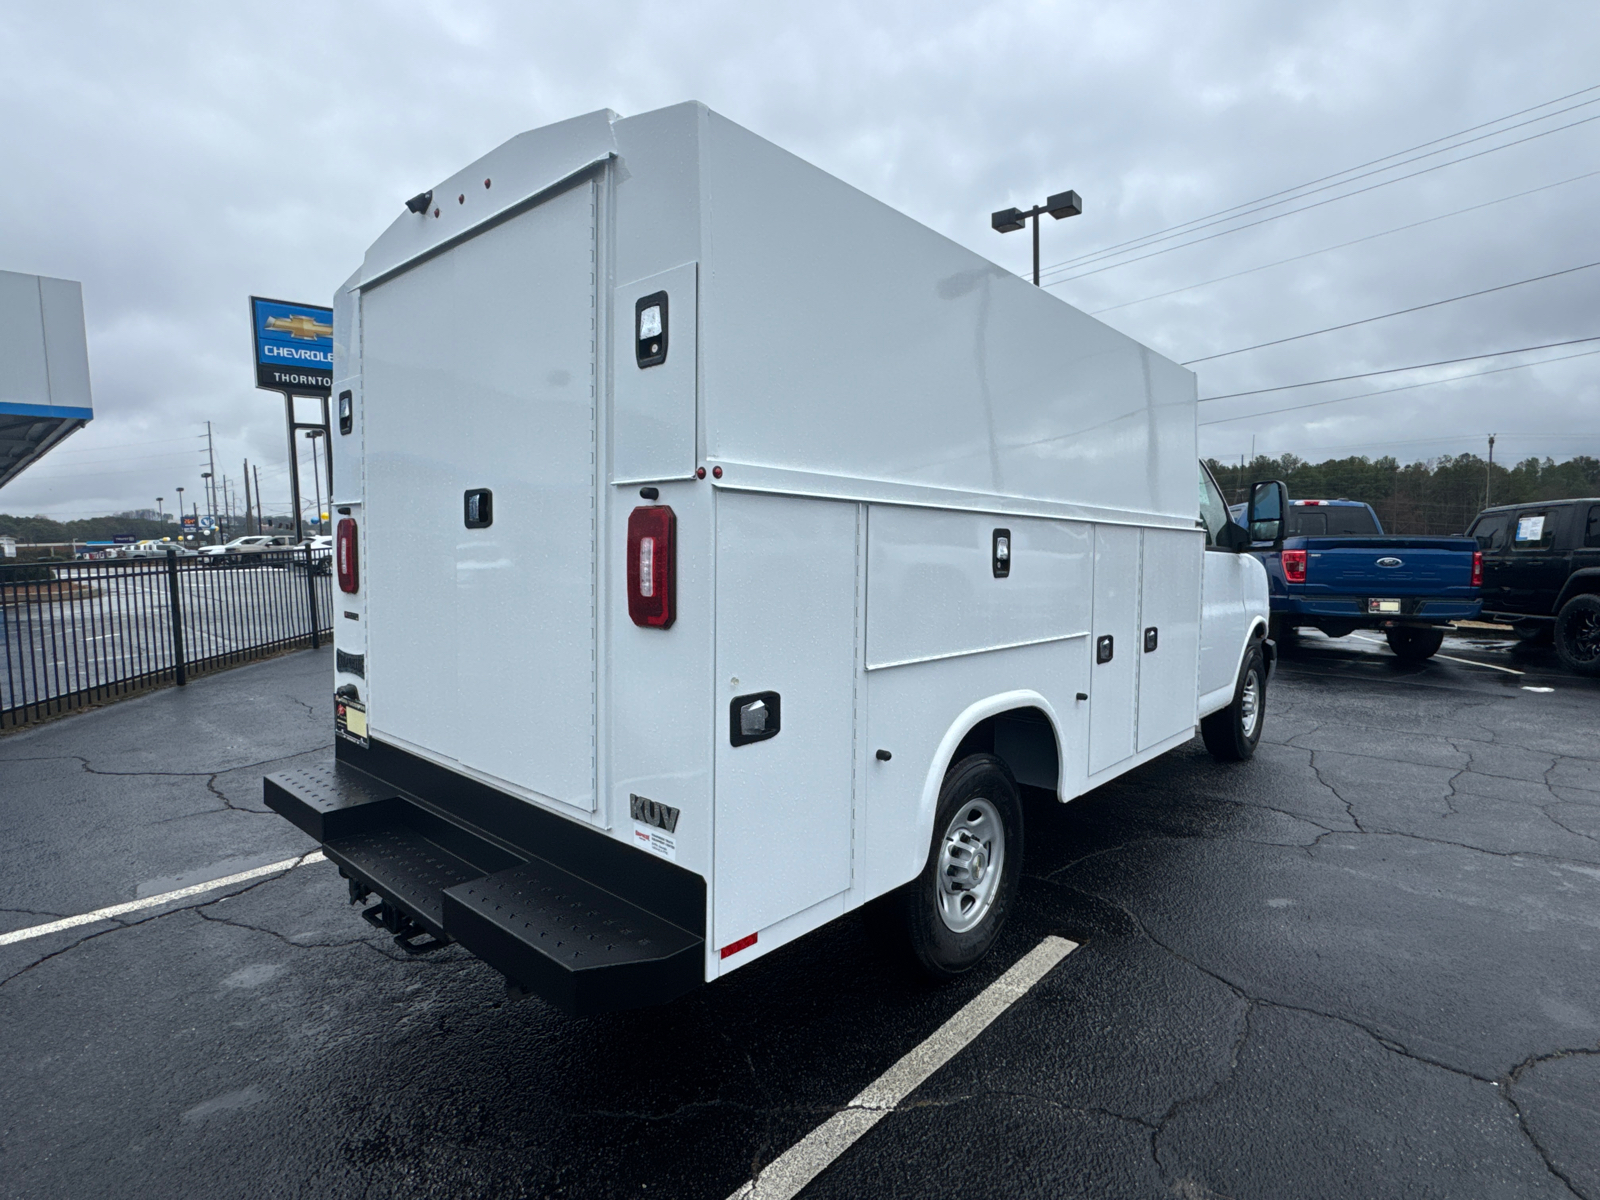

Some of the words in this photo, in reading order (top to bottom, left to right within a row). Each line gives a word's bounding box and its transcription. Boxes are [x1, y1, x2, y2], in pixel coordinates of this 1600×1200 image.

[264, 345, 333, 362] CHEVROLE
[273, 372, 333, 386] THORNTO
[630, 793, 680, 833] KUV
